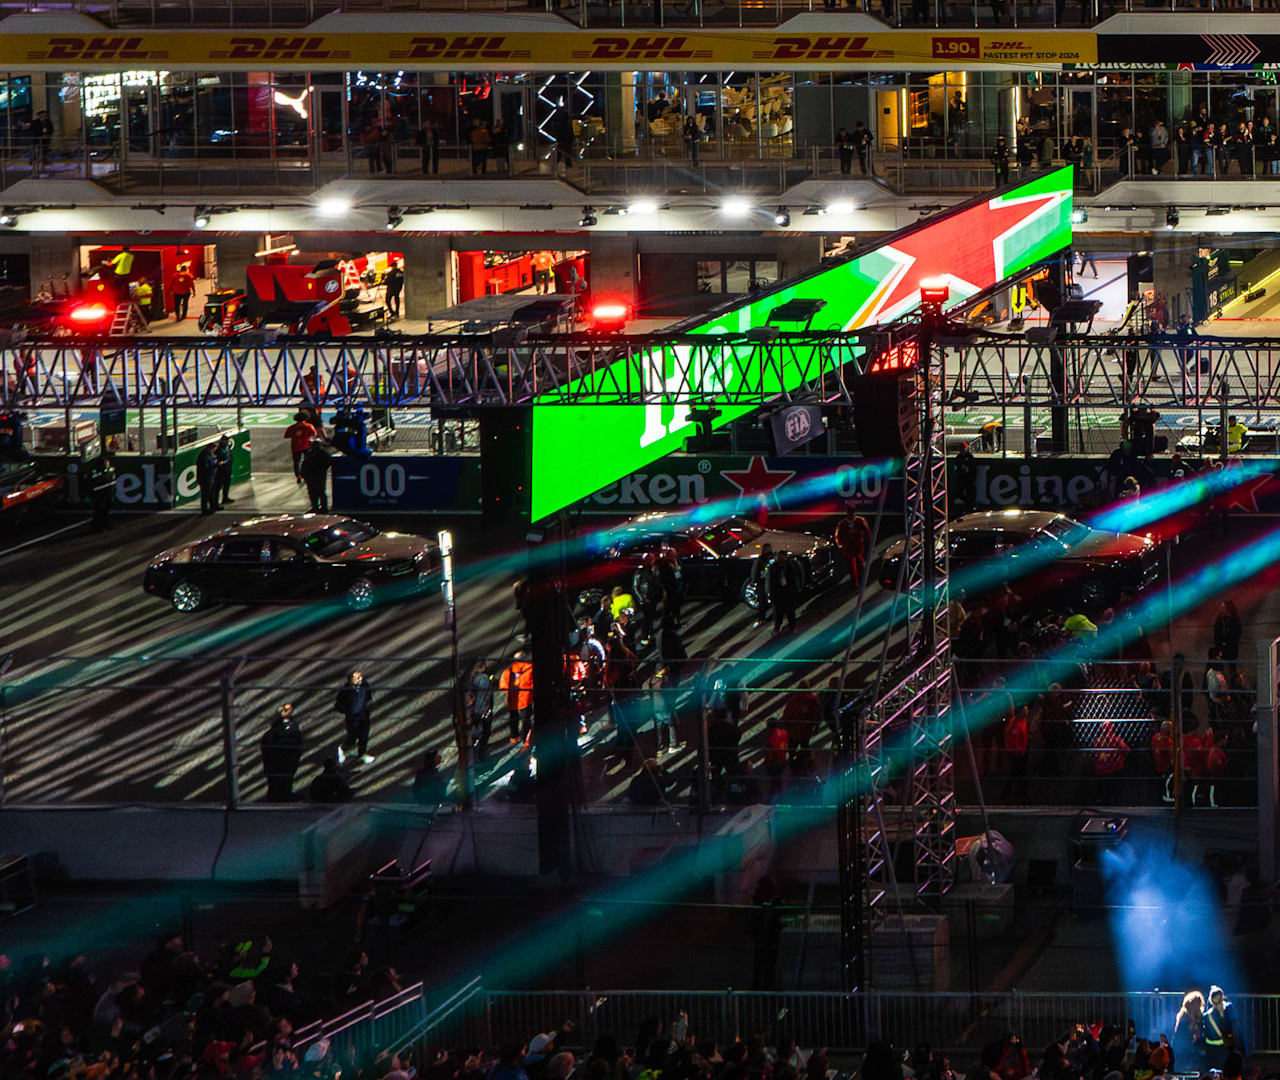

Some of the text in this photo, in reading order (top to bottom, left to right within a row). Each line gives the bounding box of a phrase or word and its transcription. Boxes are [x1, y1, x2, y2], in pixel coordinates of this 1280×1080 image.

[48, 37, 150, 59] DHL
[230, 37, 332, 59] DHL
[409, 37, 511, 59] DHL
[591, 37, 693, 59] DHL
[774, 37, 876, 59] DHL
[989, 41, 1024, 50] DHL
[1209, 291, 1217, 307] 18
[787, 414, 810, 437] FIA
[360, 464, 406, 497] 0.0
[837, 465, 882, 499] 0.0
